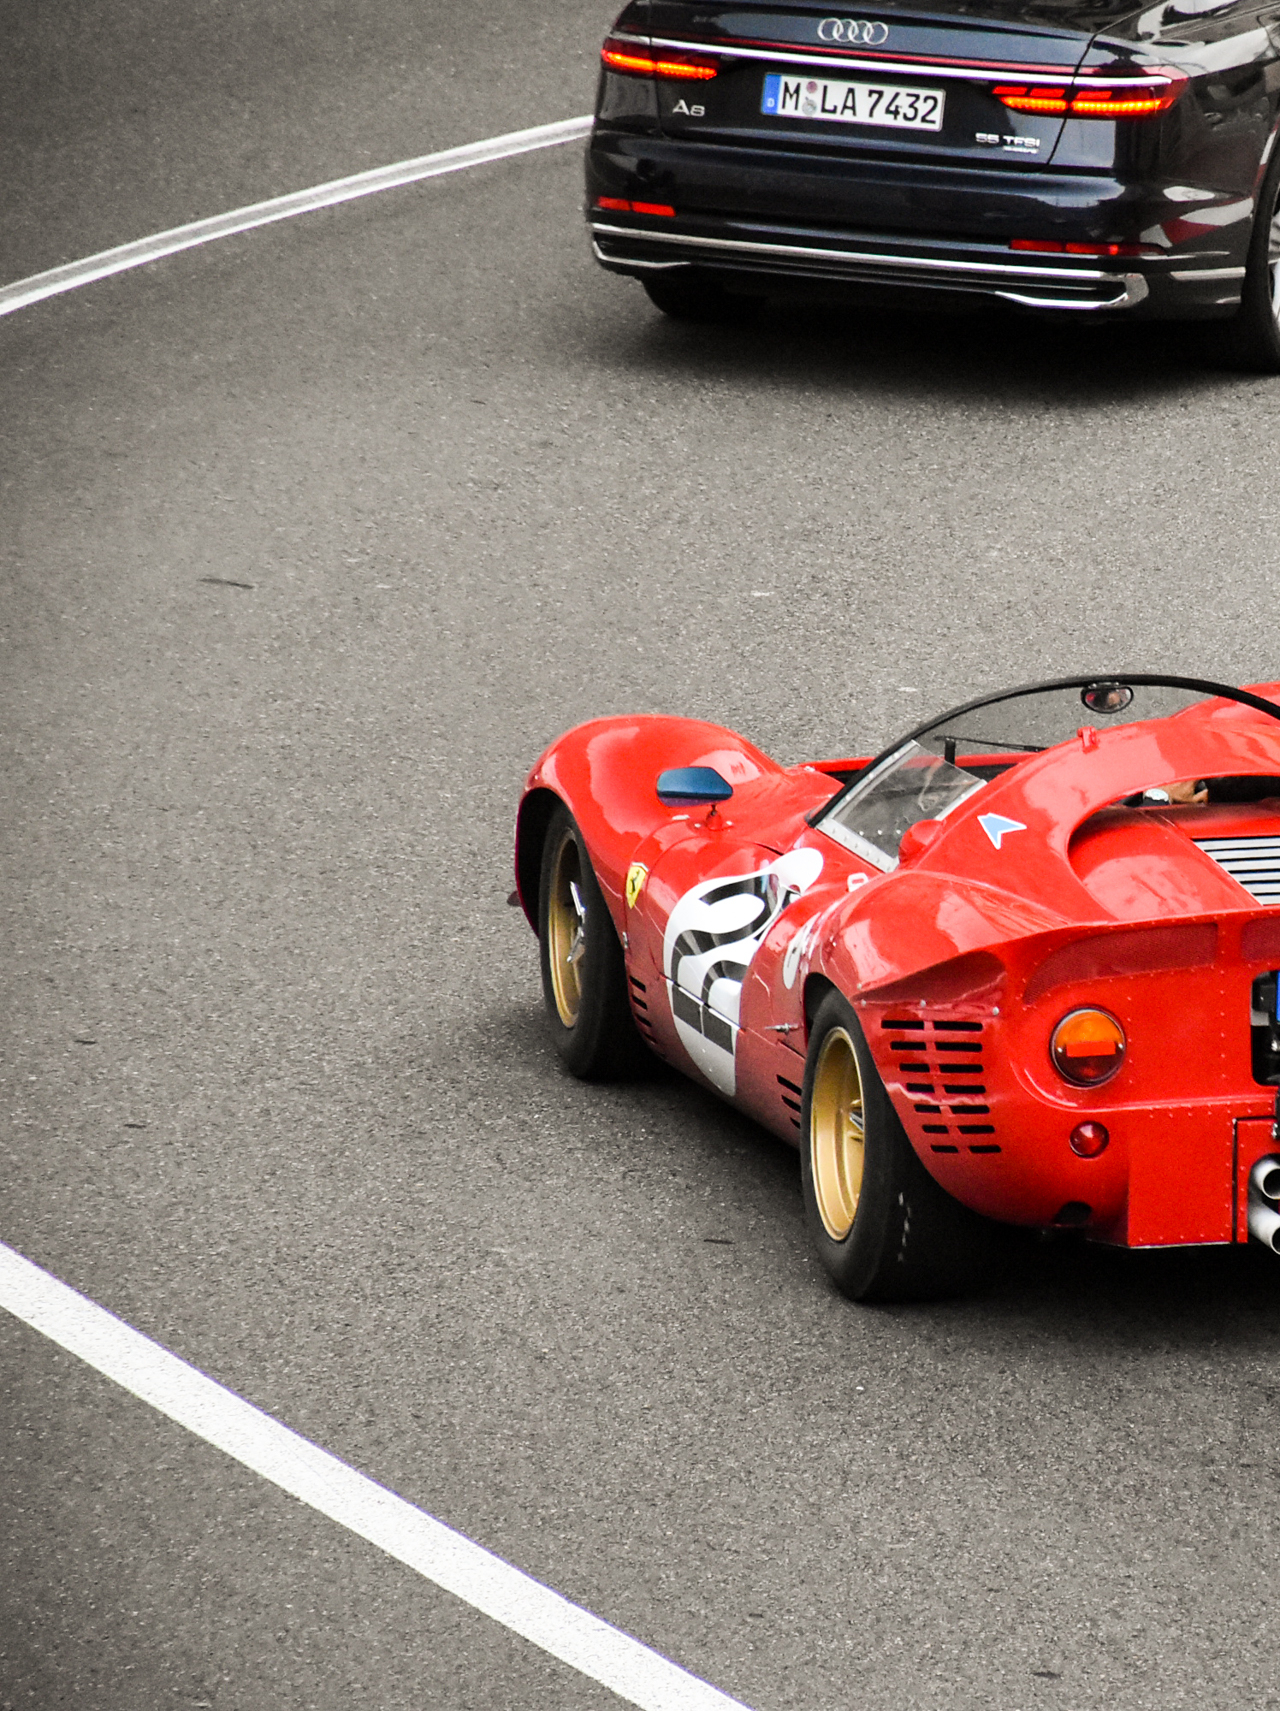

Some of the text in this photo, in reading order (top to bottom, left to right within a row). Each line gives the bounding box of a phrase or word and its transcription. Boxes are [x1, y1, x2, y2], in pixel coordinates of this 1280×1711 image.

[672, 98, 706, 117] A8
[781, 81, 938, 125] M LA 7432
[1002, 135, 1041, 148] TFSI
